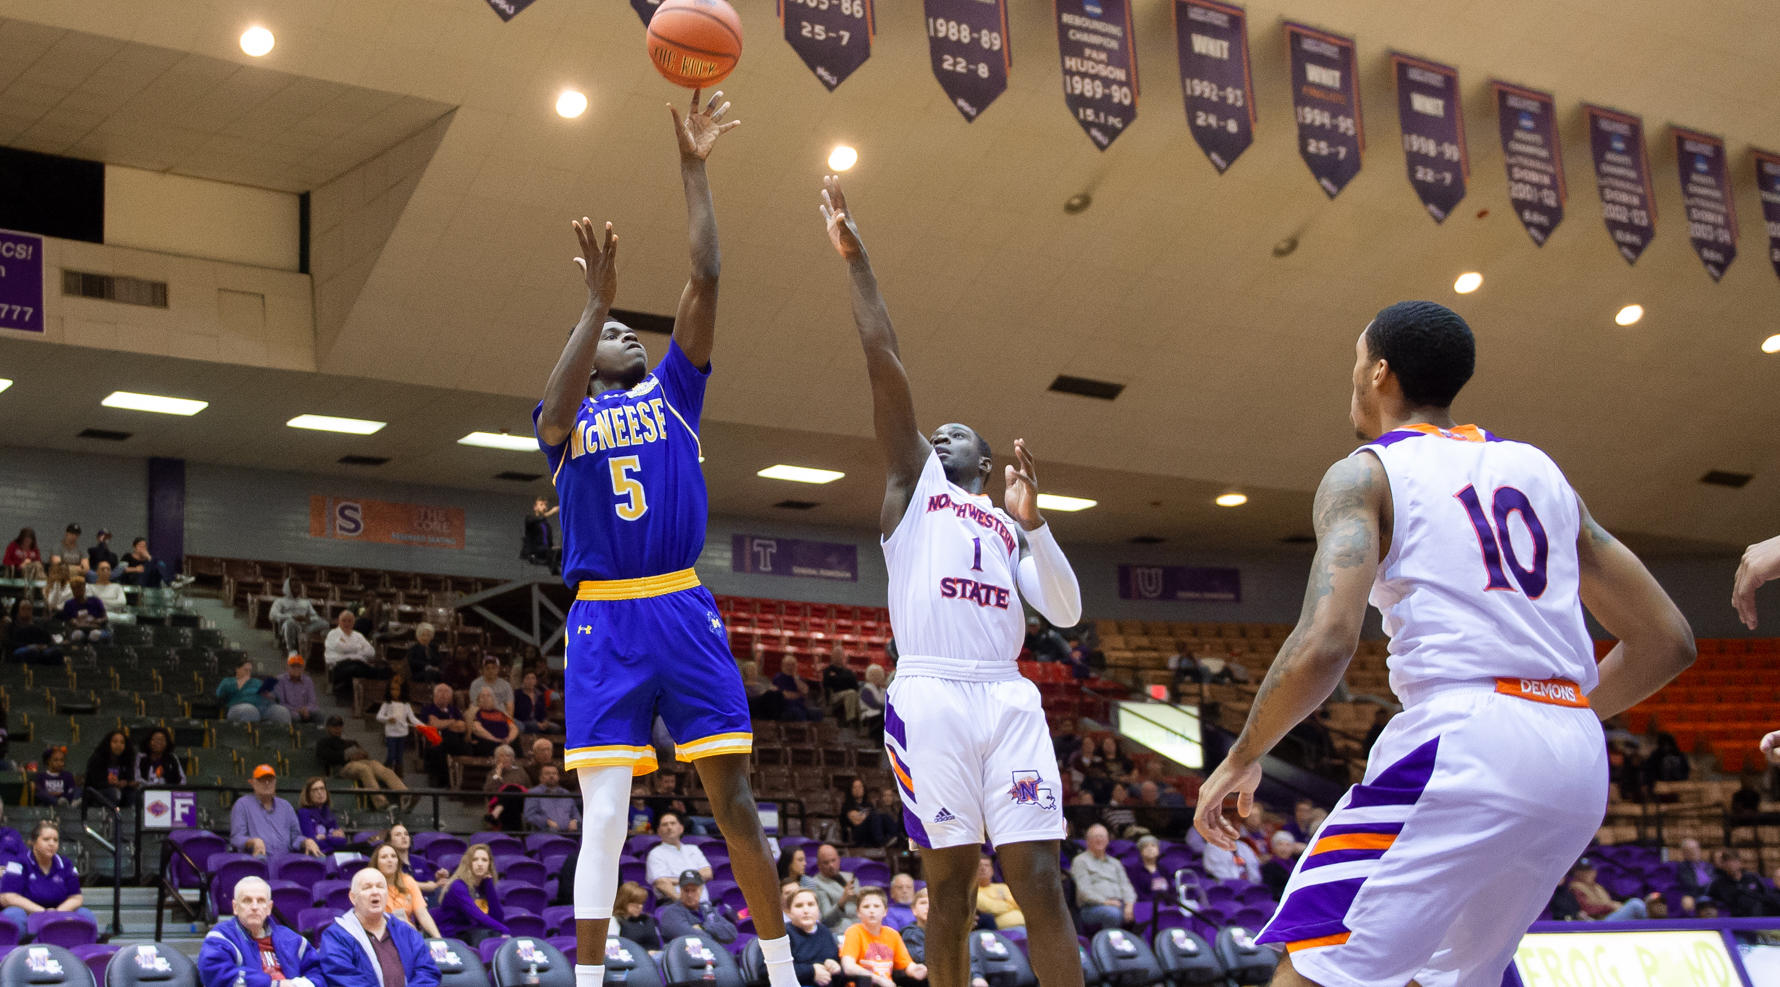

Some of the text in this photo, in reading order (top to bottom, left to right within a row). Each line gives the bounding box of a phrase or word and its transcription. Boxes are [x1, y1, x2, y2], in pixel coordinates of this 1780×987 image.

[801, 22, 850, 46] 25-7
[928, 18, 1001, 50] 1988-89
[1061, 13, 1123, 37] REBOUNDING
[1068, 29, 1119, 50] CHAMPION
[942, 55, 989, 78] 22-8
[1084, 47, 1108, 62] PAM
[1064, 55, 1126, 81] HUDSON
[1065, 75, 1131, 106] 1989-90
[1185, 78, 1244, 107] 1992-93
[1078, 107, 1105, 124] 15.1
[1196, 111, 1238, 133] 24-8
[1297, 106, 1355, 136] 1994-95
[1307, 139, 1347, 160] 25-7
[1415, 165, 1452, 186] 22-7
[571, 398, 667, 460] McNEESE
[608, 455, 648, 521] 5
[336, 502, 364, 537] S
[970, 537, 984, 572] 1
[1453, 483, 1549, 600] 10
[753, 539, 777, 572] T
[940, 577, 1010, 610] STATE
[1136, 567, 1163, 598] U
[1520, 680, 1576, 702] DEMONS
[1020, 783, 1038, 800] N
[174, 798, 194, 821] F
[934, 815, 955, 823] adidas
[1633, 940, 1730, 987] PND
